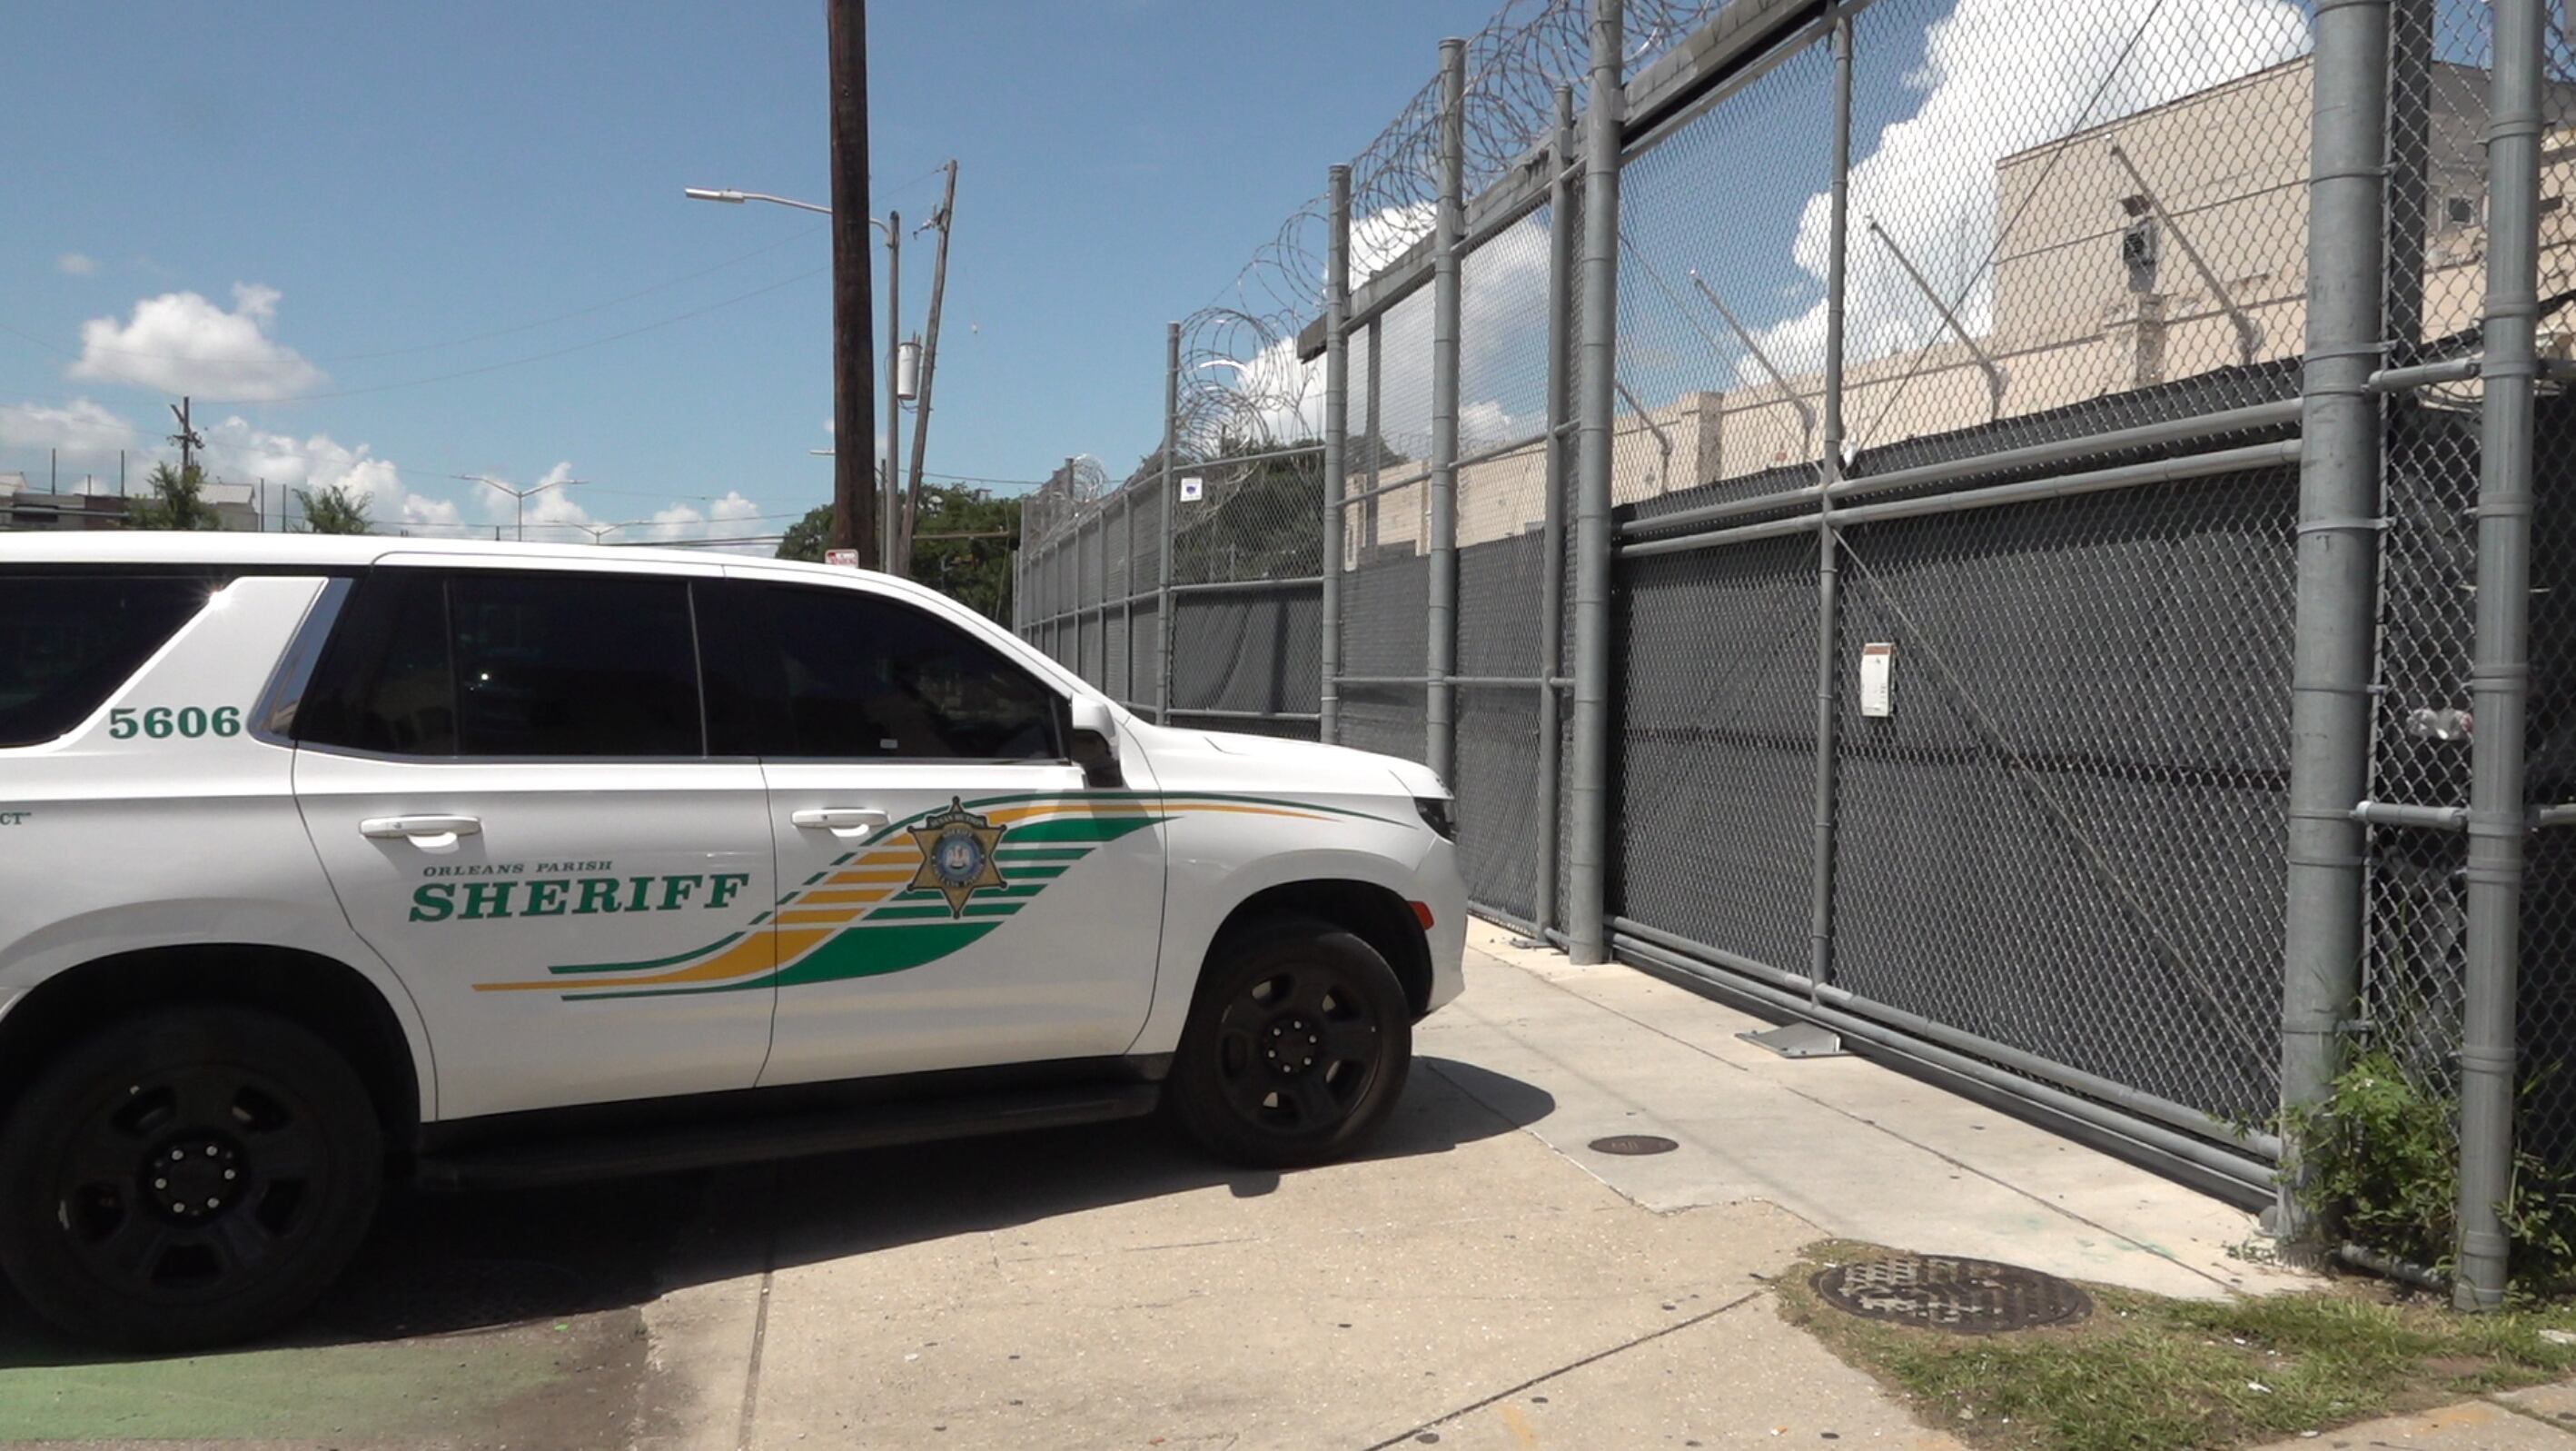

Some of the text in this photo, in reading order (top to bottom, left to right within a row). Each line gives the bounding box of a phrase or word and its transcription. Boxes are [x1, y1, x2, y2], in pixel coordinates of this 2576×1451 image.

[109, 706, 241, 739] 5606
[423, 860, 613, 878] ORLEANS PARISH
[409, 872, 749, 922] SHERIFF
